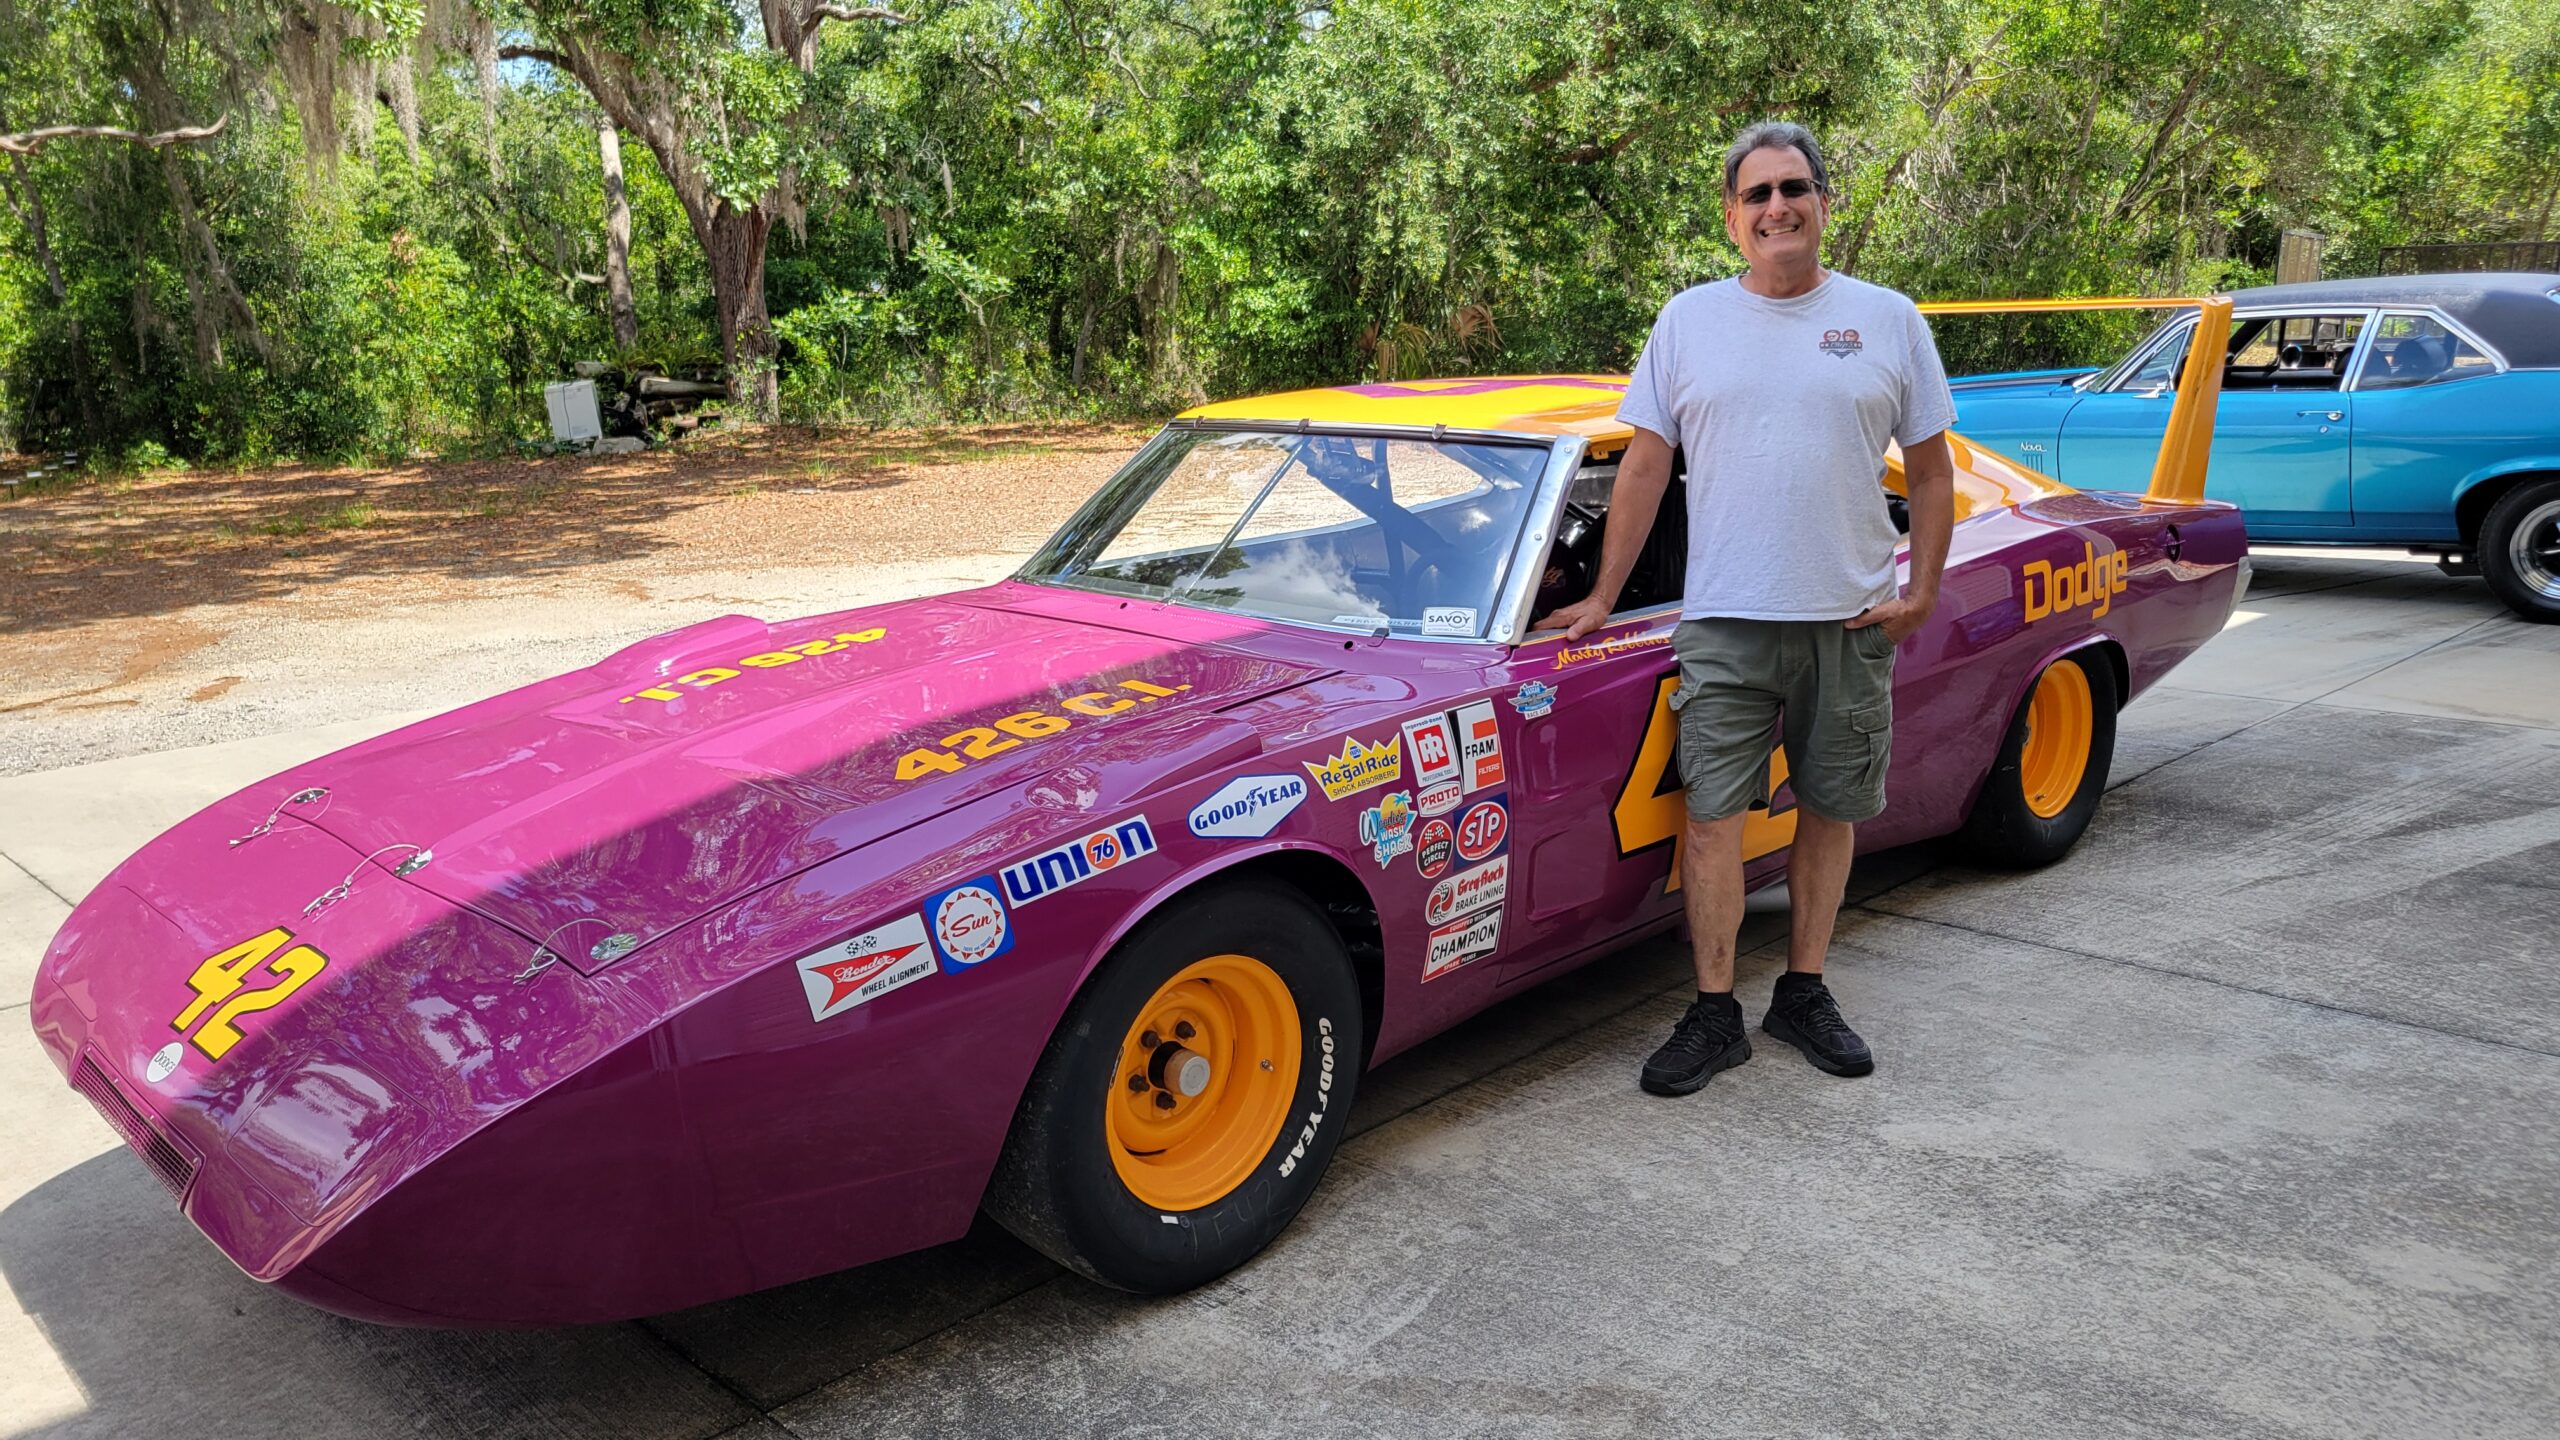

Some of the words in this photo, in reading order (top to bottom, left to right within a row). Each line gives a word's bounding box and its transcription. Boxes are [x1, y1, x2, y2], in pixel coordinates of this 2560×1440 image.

[2020, 441, 2048, 452] Nova
[2023, 541, 2128, 623] Dodge
[1428, 614, 1471, 625] SAVOY
[738, 628, 887, 668] 426
[1551, 642, 1605, 670] Marty
[895, 711, 1072, 780] 426
[1061, 679, 1194, 716] C.I.
[1465, 738, 1495, 759] FRAM
[1332, 782, 1358, 797] SHOCK
[1357, 769, 1395, 788] ABSORBERS
[1478, 763, 1500, 776] FILTERS
[1420, 786, 1459, 808] PROTO
[1381, 825, 1405, 842] WASH
[1464, 807, 1500, 848] STP
[1092, 838, 1115, 864] 76
[1376, 833, 1411, 861] SHACK
[1421, 840, 1449, 859] PERFECT
[1423, 851, 1446, 867] CIRCLE
[1455, 893, 1478, 913] BRAKE
[1479, 884, 1504, 903] LINING
[950, 913, 992, 938] Sun
[1431, 921, 1497, 963] CHAMPION
[1443, 959, 1460, 971] SPARK
[1460, 952, 1477, 964] PLUGS
[861, 981, 887, 997] WHEEL
[888, 961, 930, 983] ALIGNMENT
[169, 925, 330, 1064] 42
